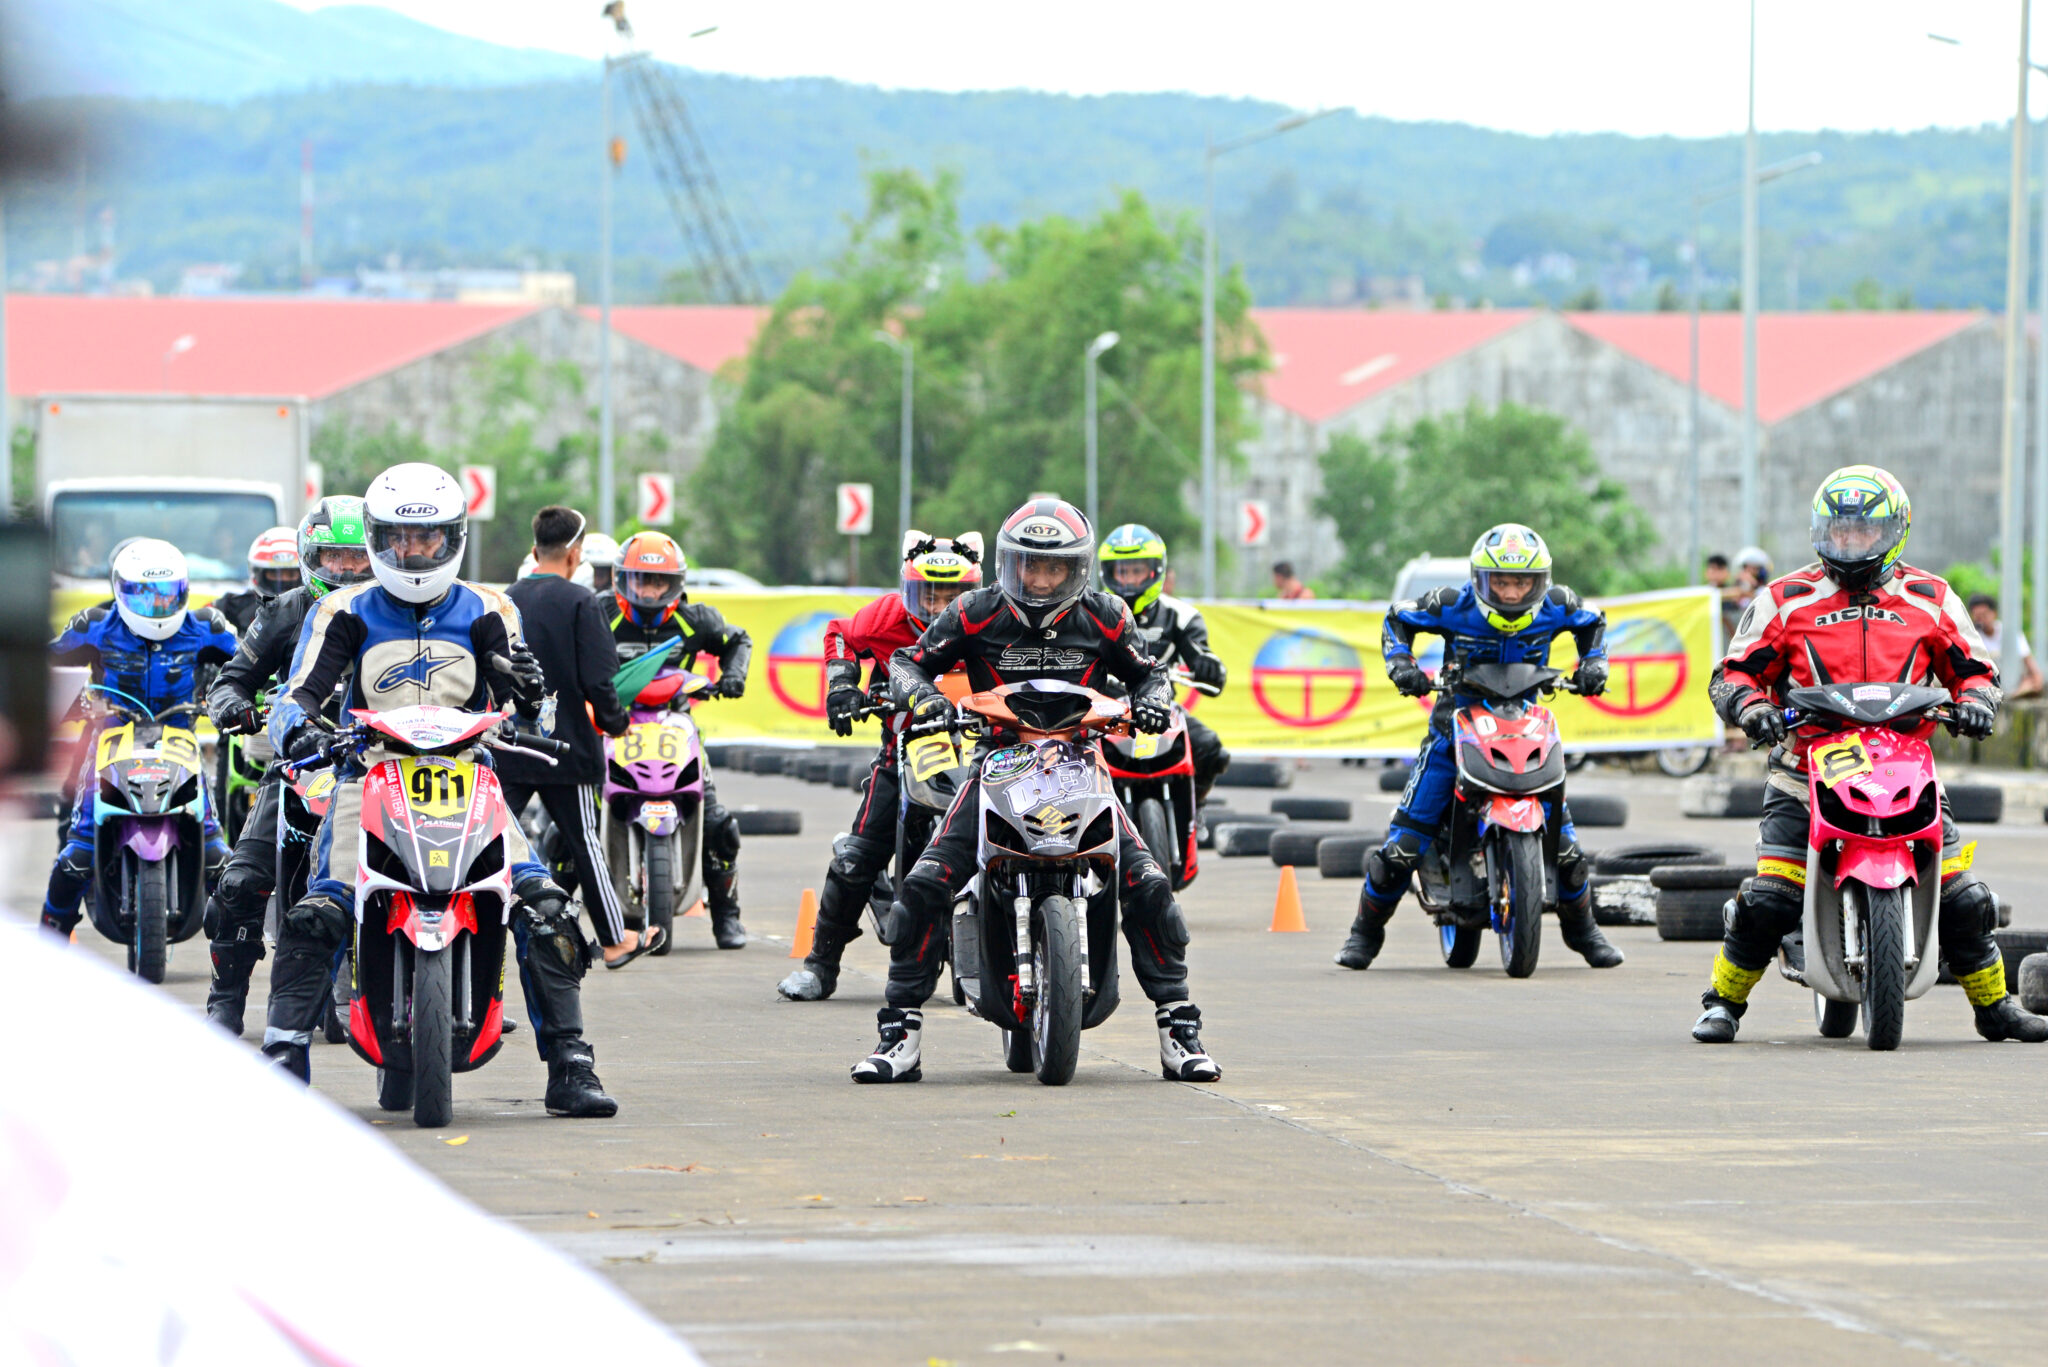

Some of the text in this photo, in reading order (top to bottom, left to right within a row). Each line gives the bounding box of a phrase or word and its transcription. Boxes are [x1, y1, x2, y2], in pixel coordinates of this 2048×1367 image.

[400, 507, 433, 515] HJC
[1026, 525, 1056, 535] KYT
[641, 554, 665, 563] KYT
[929, 557, 956, 565] KYT
[103, 733, 124, 761] 1
[623, 732, 677, 761] 86
[917, 742, 951, 775] 2
[1823, 744, 1865, 779] 8
[384, 760, 406, 817] YUASA BATTERY
[412, 767, 465, 808] 911
[473, 794, 485, 820] YUASA
[424, 820, 463, 828] PLATINUM
